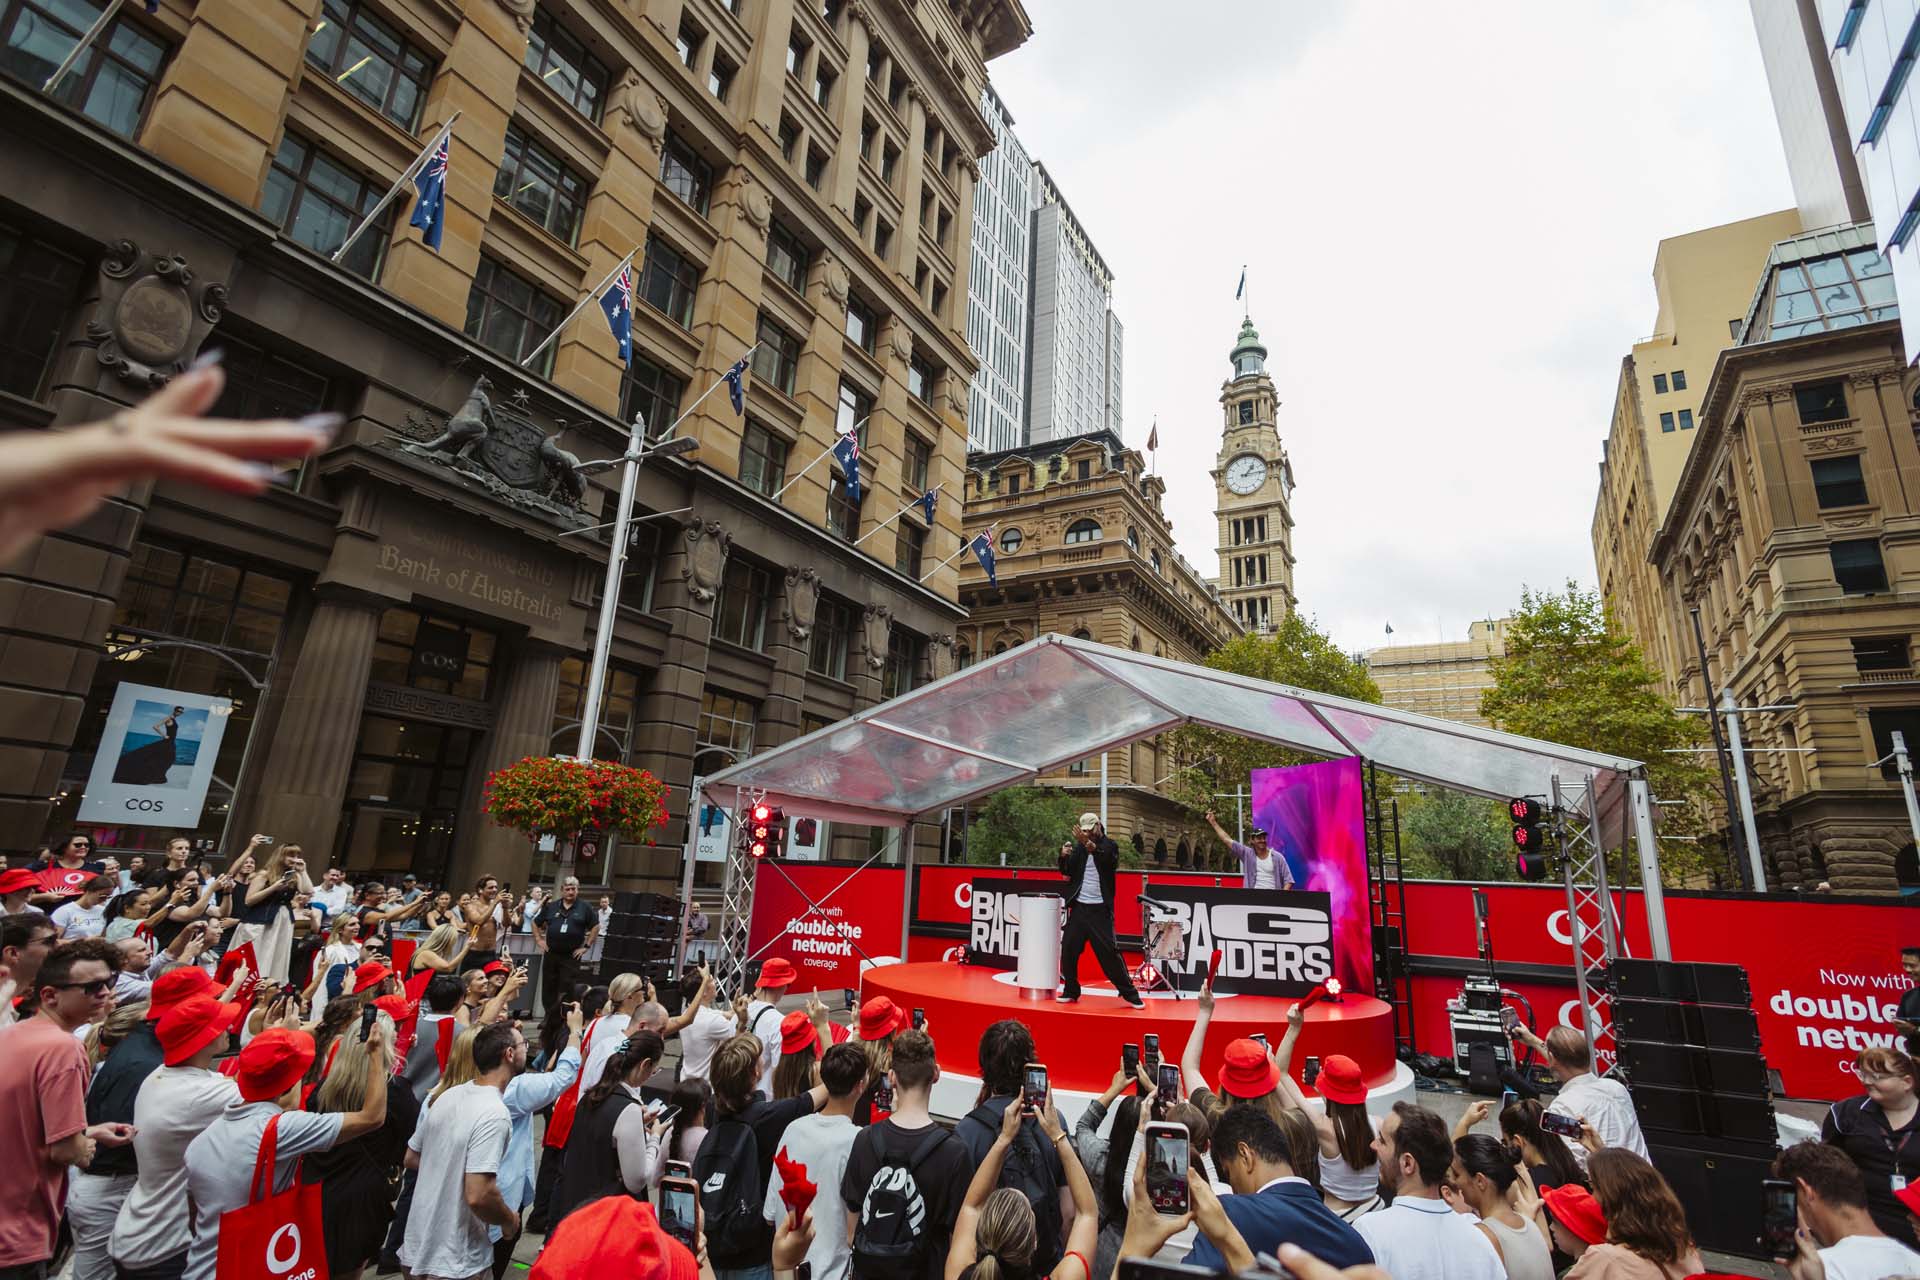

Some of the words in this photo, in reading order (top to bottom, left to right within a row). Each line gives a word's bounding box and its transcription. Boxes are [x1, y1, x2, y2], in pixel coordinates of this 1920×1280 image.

[376, 544, 441, 584] Bank
[445, 569, 469, 592] of
[469, 573, 562, 621] Australia
[420, 651, 458, 671] COS
[125, 798, 164, 812] COS
[699, 845, 714, 853] COS
[826, 906, 843, 917] with
[786, 918, 836, 937] double
[837, 921, 862, 939] the
[792, 938, 852, 956] network
[803, 958, 839, 971] coverage
[1819, 968, 1866, 987] Now
[1870, 973, 1915, 990] with
[1770, 989, 1899, 1023] double
[1797, 1025, 1912, 1060] netw
